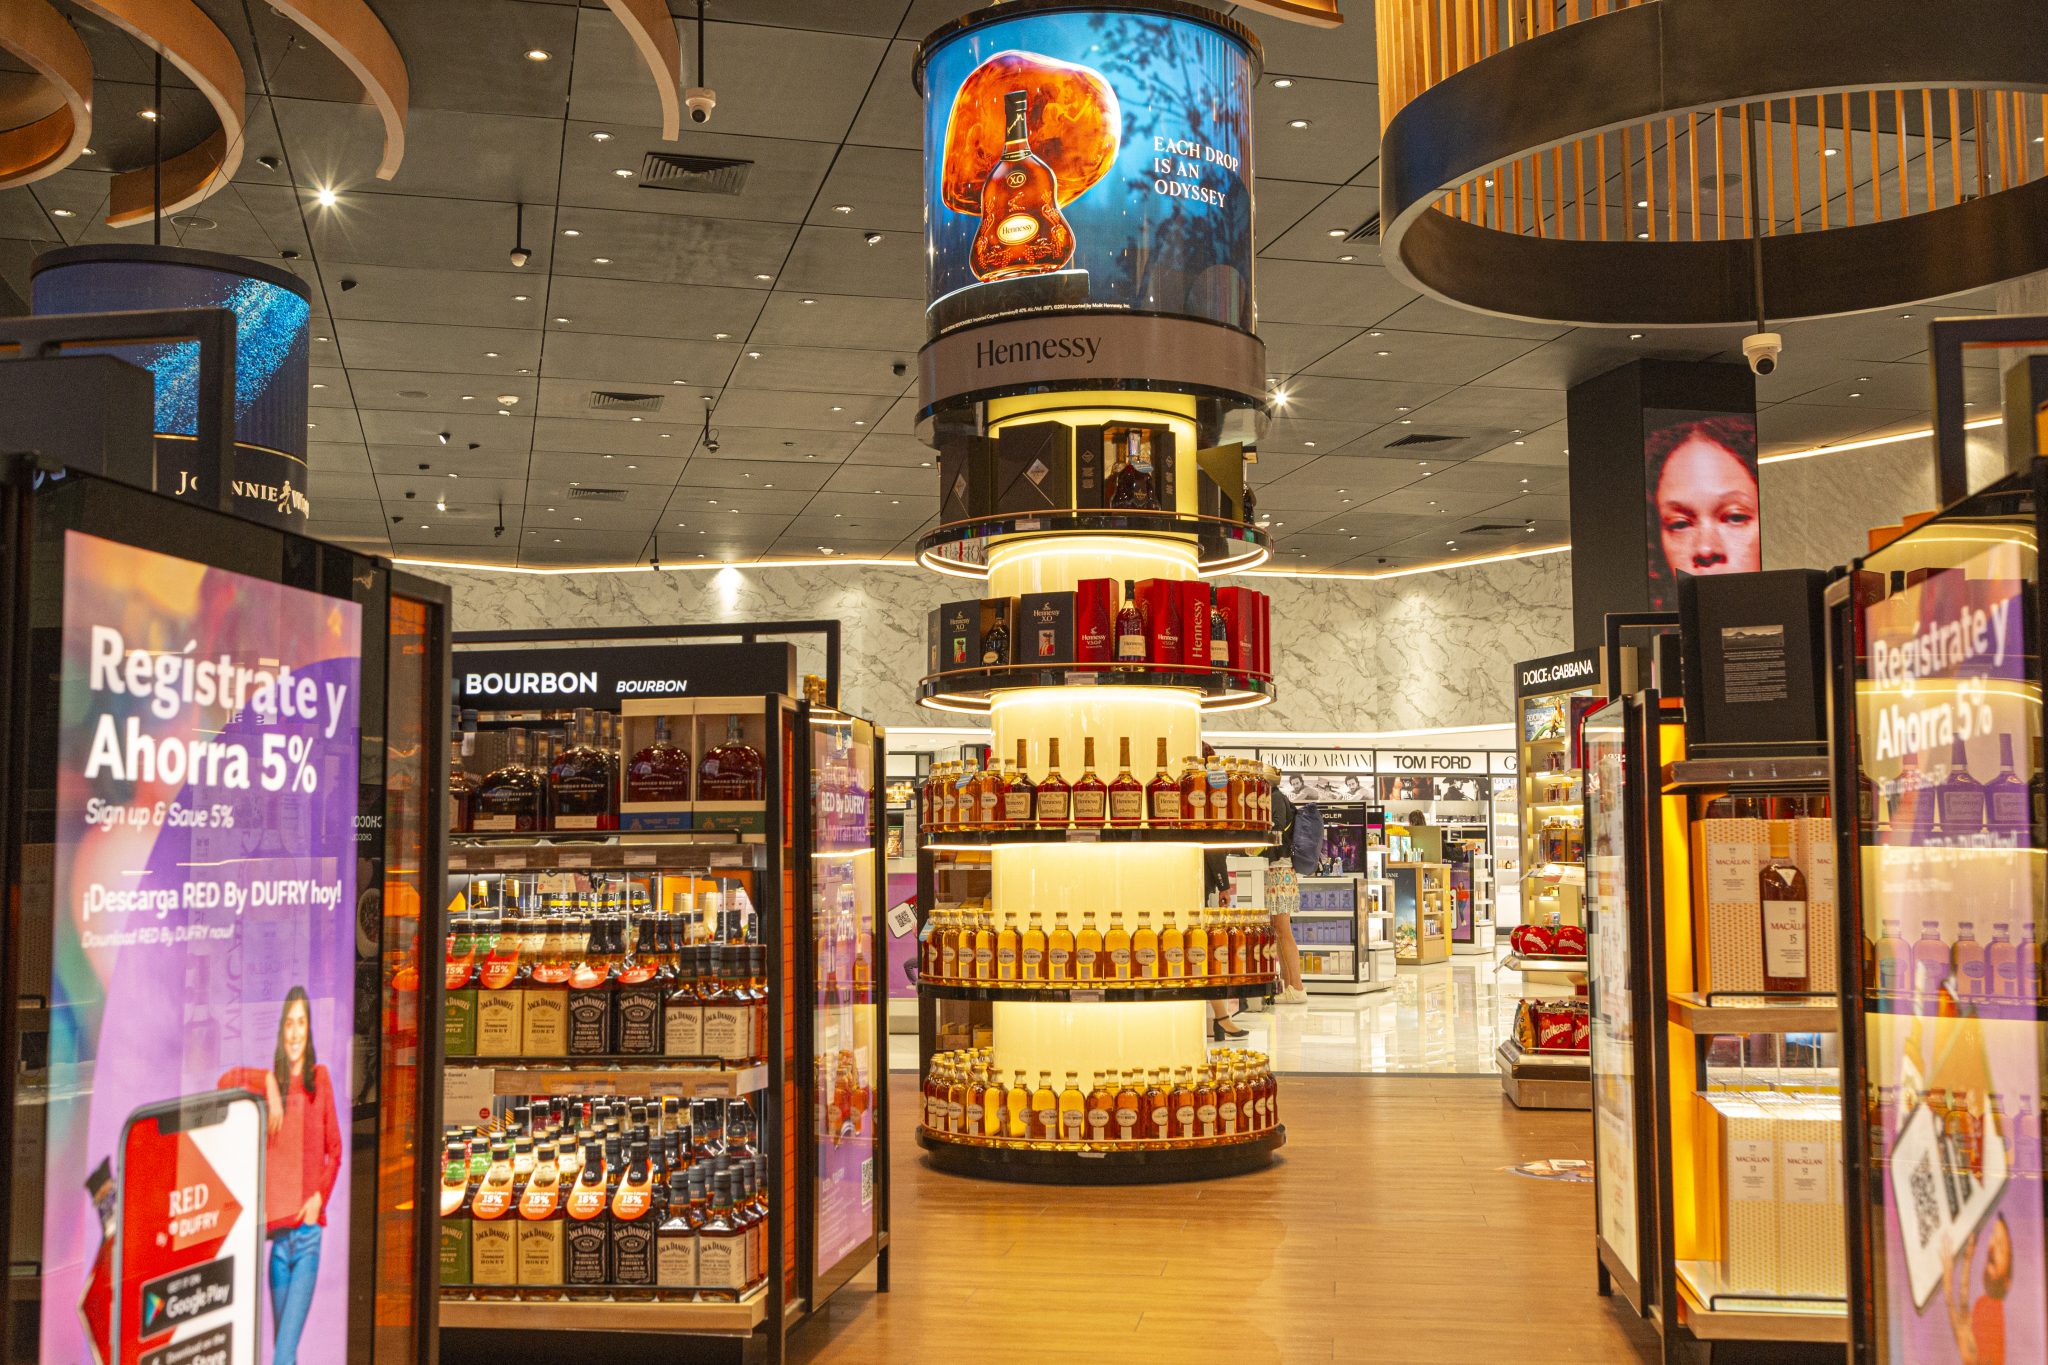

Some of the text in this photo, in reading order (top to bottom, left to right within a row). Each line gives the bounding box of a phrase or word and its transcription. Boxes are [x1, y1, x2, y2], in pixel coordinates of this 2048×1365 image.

[1154, 135, 1238, 172] EACH DROP
[1154, 157, 1199, 180] IS AN
[1154, 179, 1225, 209] ODYSSEY
[1002, 223, 1034, 237] Hennessy
[977, 336, 1102, 369] Hennessy
[1193, 598, 1206, 659] Hennessy
[1873, 605, 1989, 699] Regístrate
[1990, 598, 2009, 667] y
[90, 625, 347, 739] Regístrate y
[465, 671, 688, 695] BOURBON BOURBON
[1876, 673, 1993, 761] Ahorra 5%
[84, 713, 318, 794] Ahorra 5%
[1260, 752, 1373, 768] GIORGIO ARMANI
[1393, 755, 1472, 769] TOM FORD
[85, 797, 125, 833] Sign
[128, 803, 150, 831] up
[210, 804, 235, 830] 5%
[821, 792, 835, 813] RED
[844, 793, 866, 815] DUFRY
[1715, 858, 1751, 866] MACALLAN
[182, 882, 220, 909] RED
[224, 882, 249, 914] By
[251, 879, 307, 907] DUFRY
[311, 879, 342, 911] hoy!
[1770, 922, 1805, 931] MACALL
[1789, 933, 1798, 945] 15
[489, 964, 510, 974] 15%
[1735, 1155, 1770, 1164] MACALLAN
[1787, 1157, 1823, 1166] MACALLAN
[169, 1183, 210, 1218] RED
[482, 1194, 503, 1205] 15%
[529, 1195, 550, 1206] 15%
[577, 1195, 599, 1205] 15%
[622, 1195, 643, 1205] 15%
